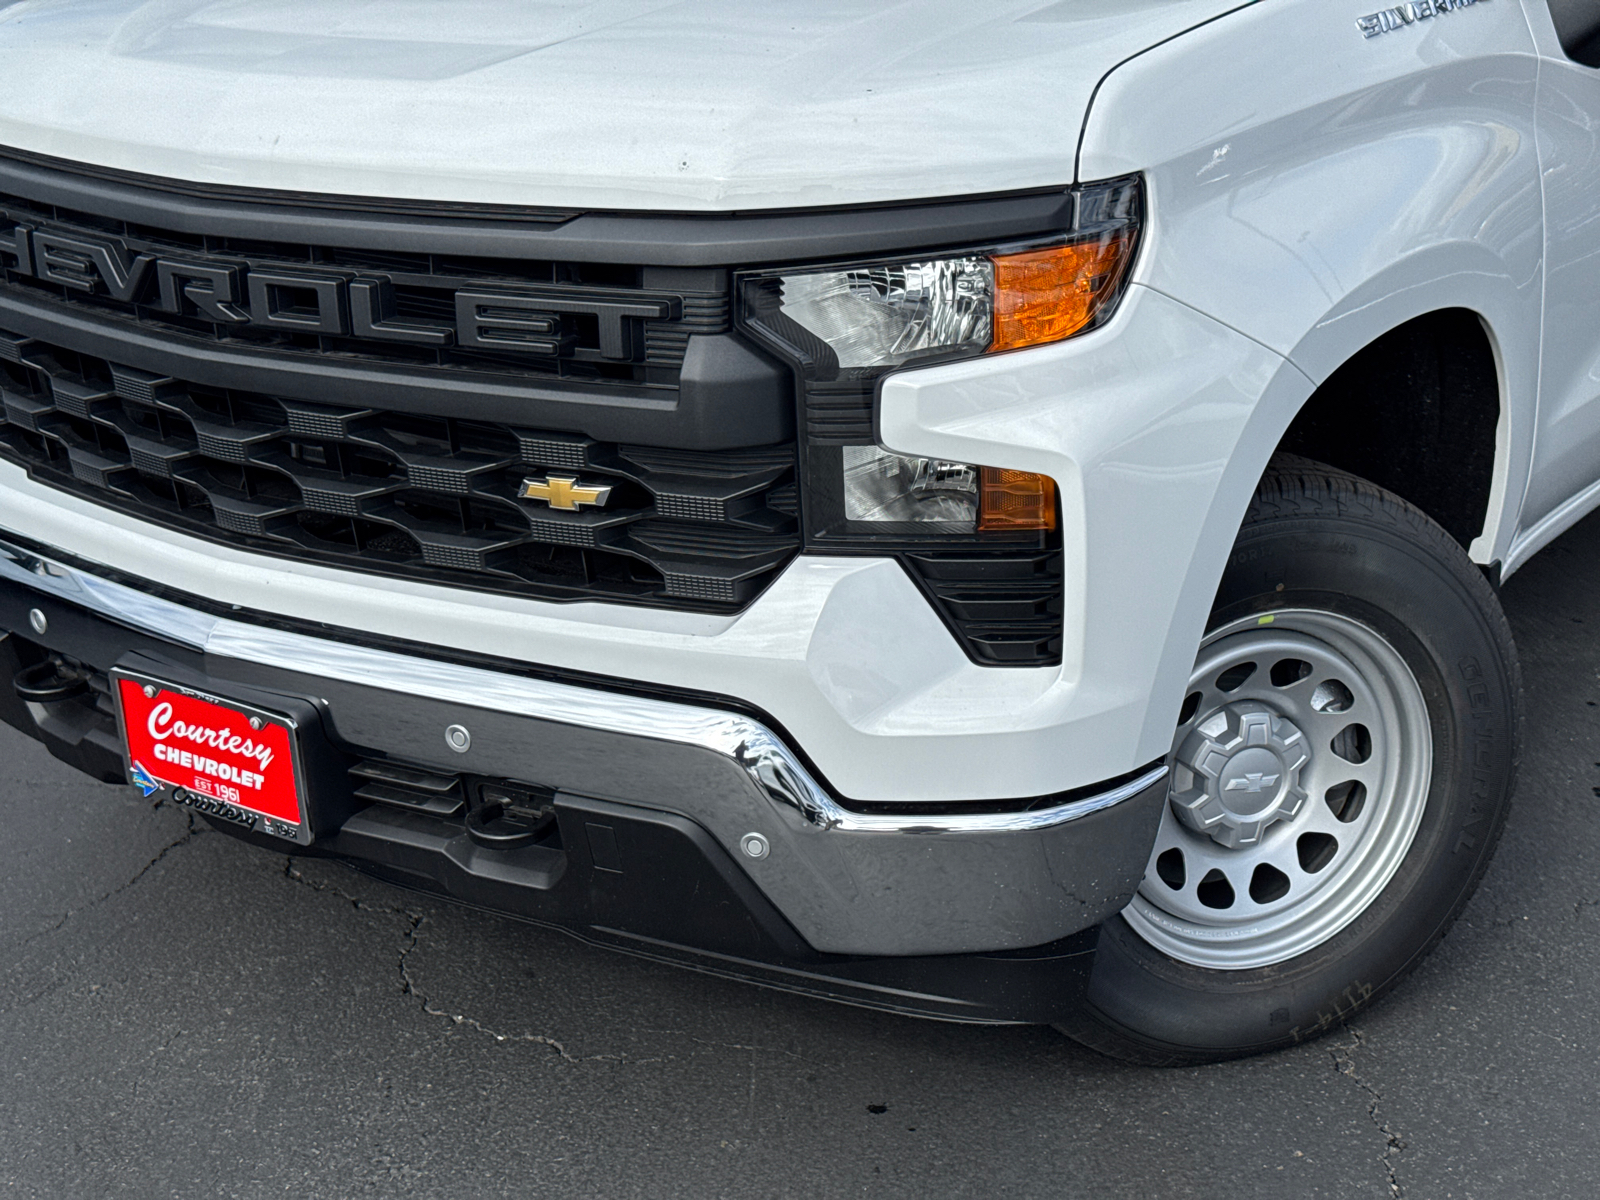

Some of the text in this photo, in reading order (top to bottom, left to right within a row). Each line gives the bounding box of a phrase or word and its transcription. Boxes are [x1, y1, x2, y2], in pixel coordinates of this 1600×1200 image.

[147, 702, 275, 771] Courtesy
[153, 743, 265, 790] CHEVROLET
[214, 783, 241, 803] 1961
